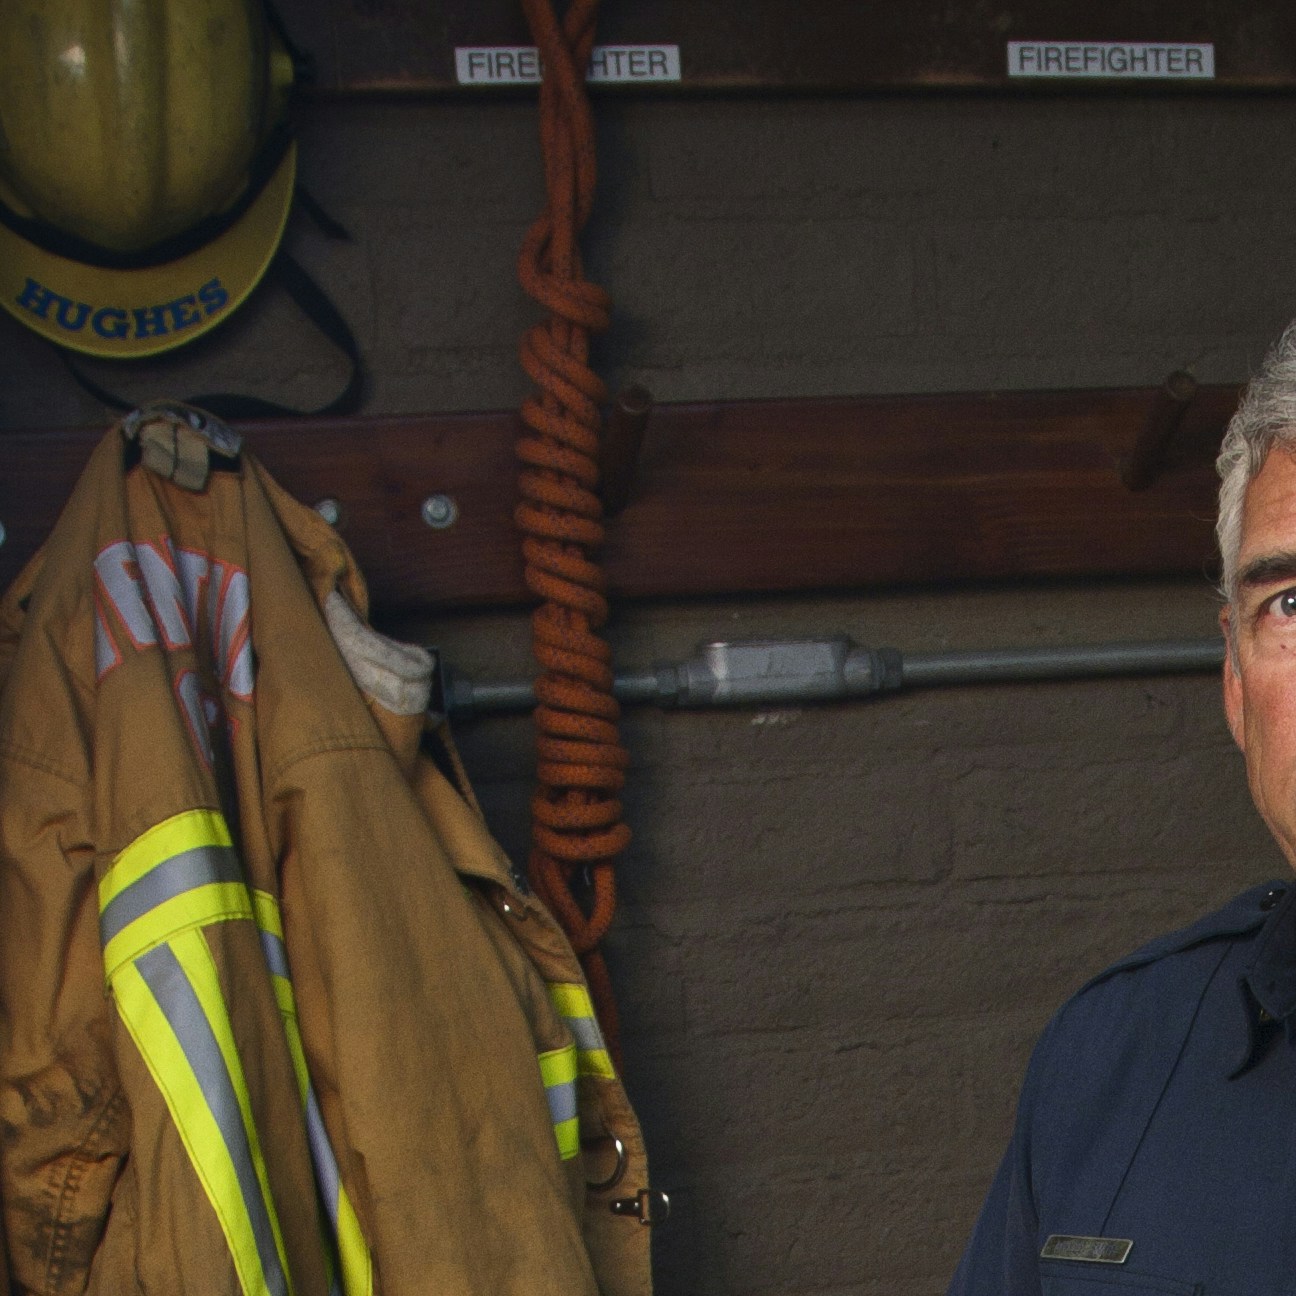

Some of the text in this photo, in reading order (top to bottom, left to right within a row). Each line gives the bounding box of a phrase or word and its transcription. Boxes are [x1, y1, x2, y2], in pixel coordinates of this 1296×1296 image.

[467, 50, 669, 79] FIREHTER
[1019, 46, 1203, 73] FIREFIGHTER
[15, 276, 229, 340] HUGHES
